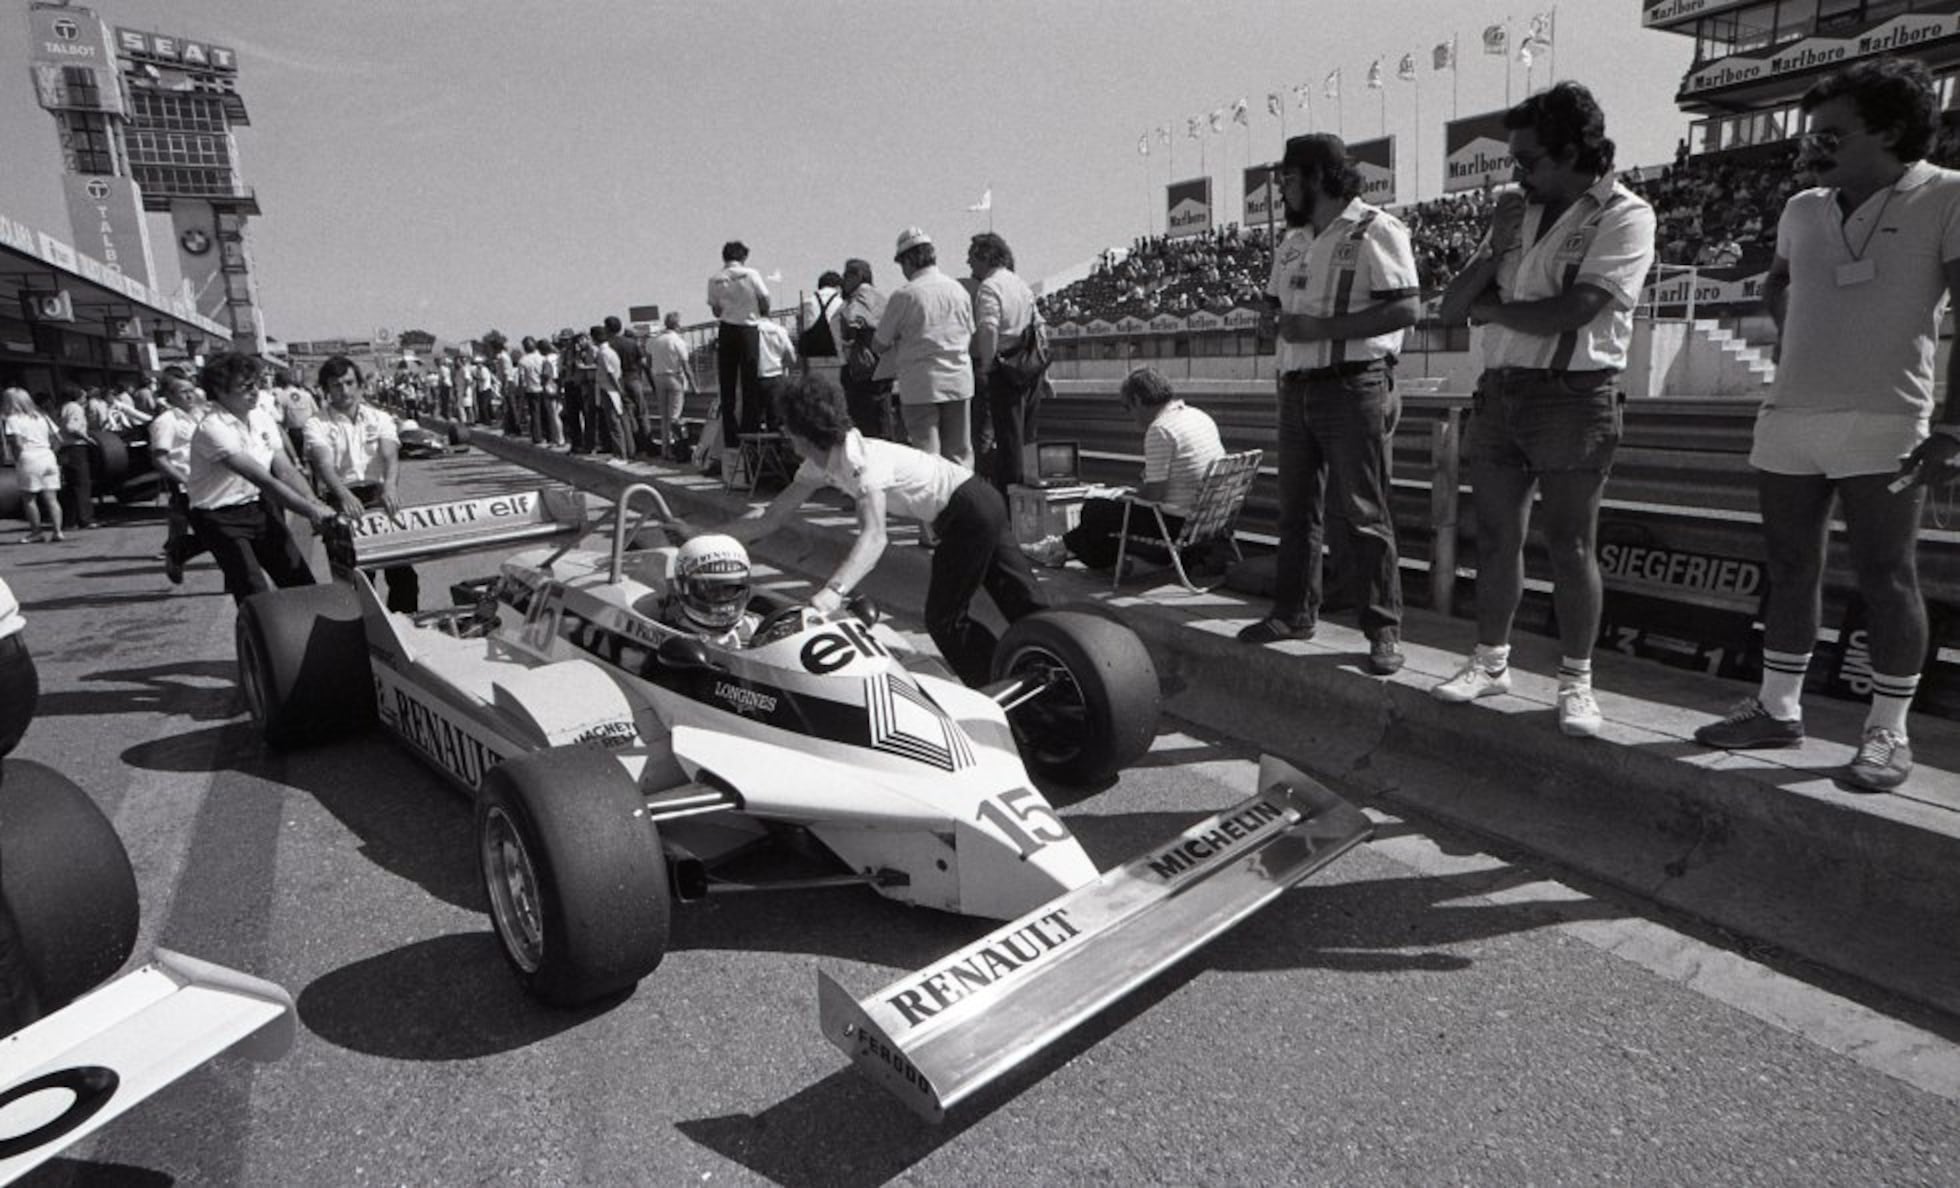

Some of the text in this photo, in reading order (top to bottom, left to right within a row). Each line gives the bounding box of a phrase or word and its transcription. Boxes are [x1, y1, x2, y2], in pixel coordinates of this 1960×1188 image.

[44, 41, 95, 57] TALBOT
[121, 31, 231, 66] SEAT
[1695, 22, 1943, 90] Marlboro Marlboro Marlboro
[1449, 151, 1514, 178] Marlboro
[490, 495, 528, 517] elf
[1600, 544, 1760, 595] SIEGFRIED
[800, 621, 888, 676] elf
[714, 680, 778, 714] LONGINES
[393, 686, 506, 788] RENAU
[976, 786, 1073, 857] 15
[1148, 801, 1283, 879] MICHELIN
[886, 908, 1083, 1029] RENAULT
[857, 1028, 930, 1094] FERODO
